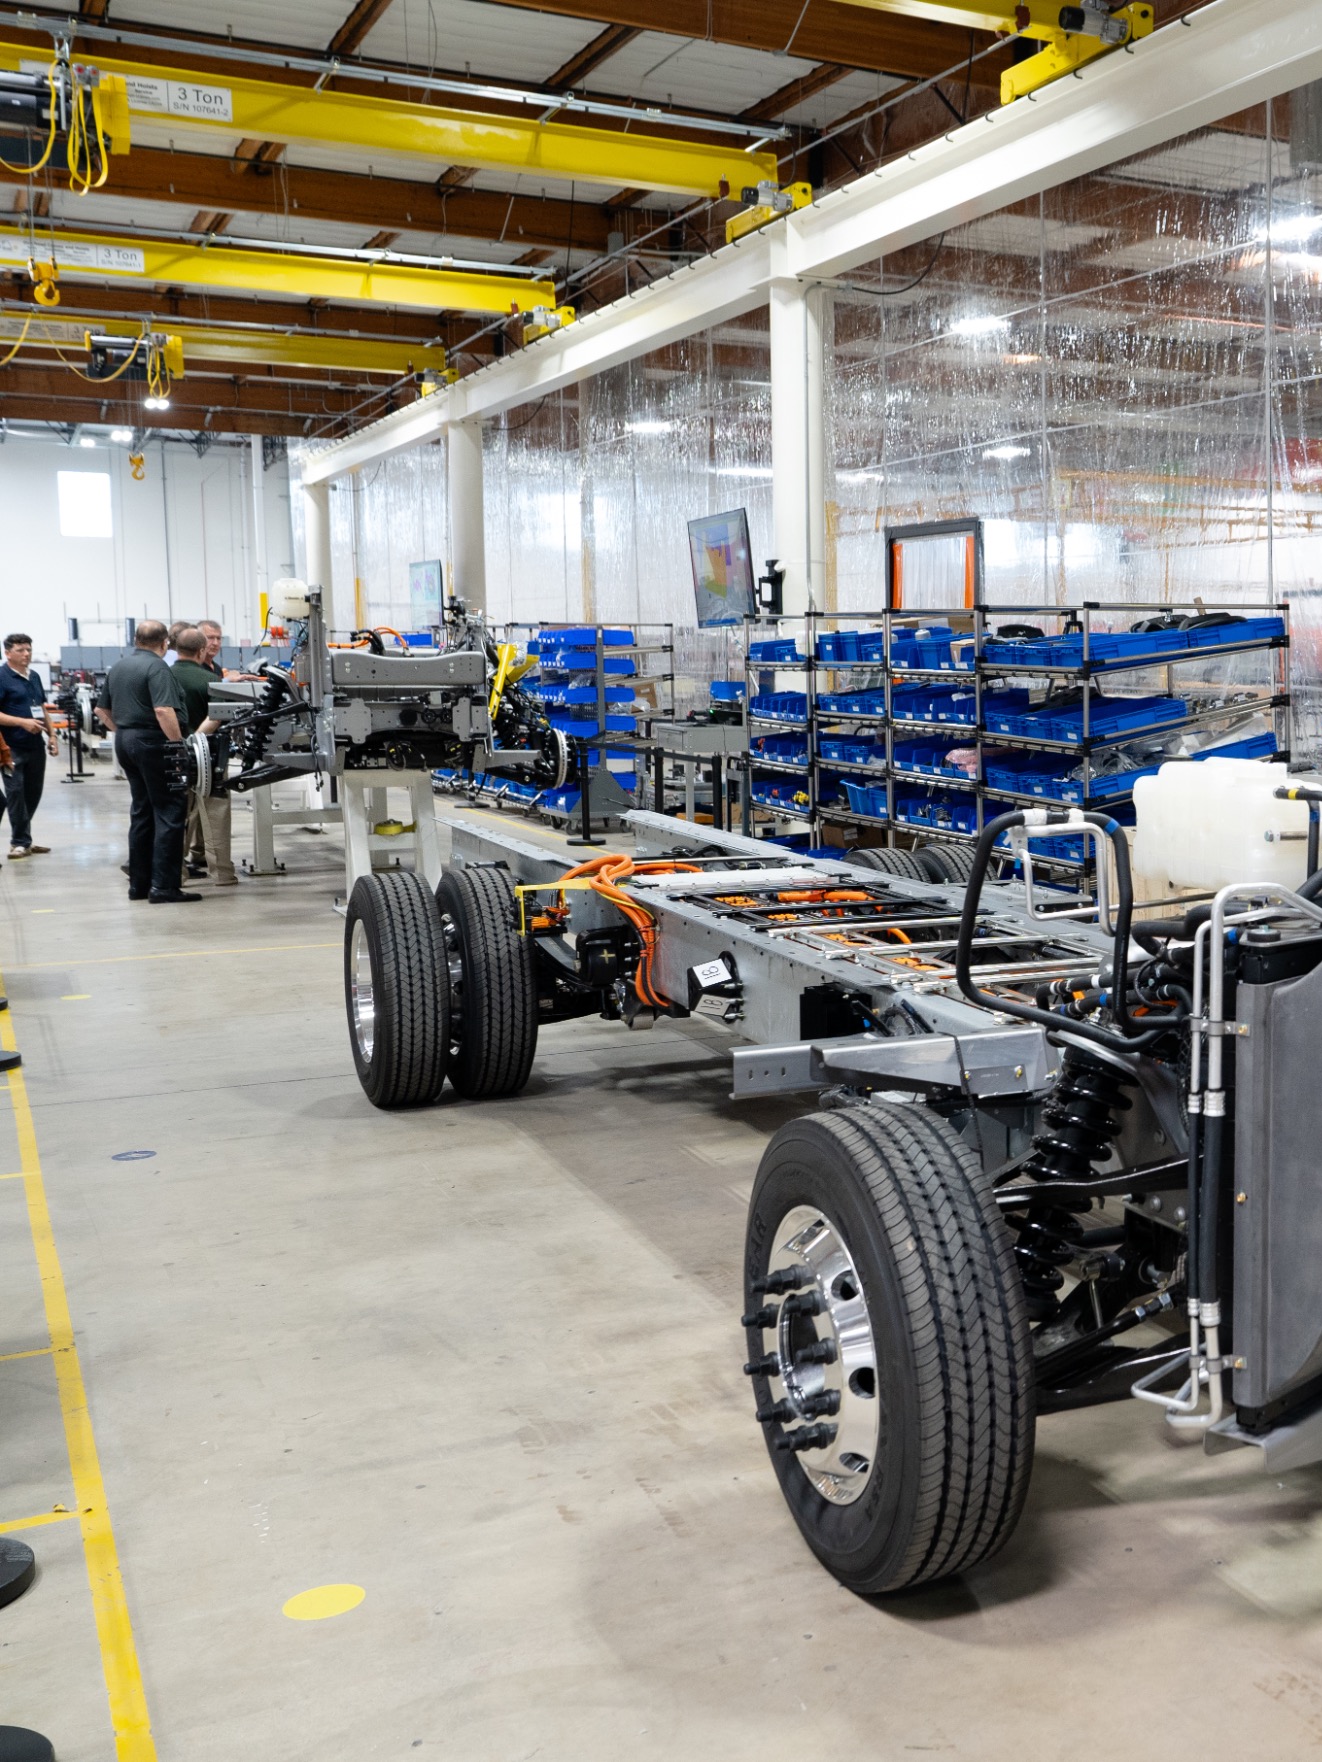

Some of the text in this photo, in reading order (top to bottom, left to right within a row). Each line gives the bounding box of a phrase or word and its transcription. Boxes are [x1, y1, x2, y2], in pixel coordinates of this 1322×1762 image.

[178, 87, 223, 105] 3 Ton
[173, 102, 190, 111] S/N
[193, 105, 229, 116] 107641-2
[104, 248, 137, 260] 3 Ton
